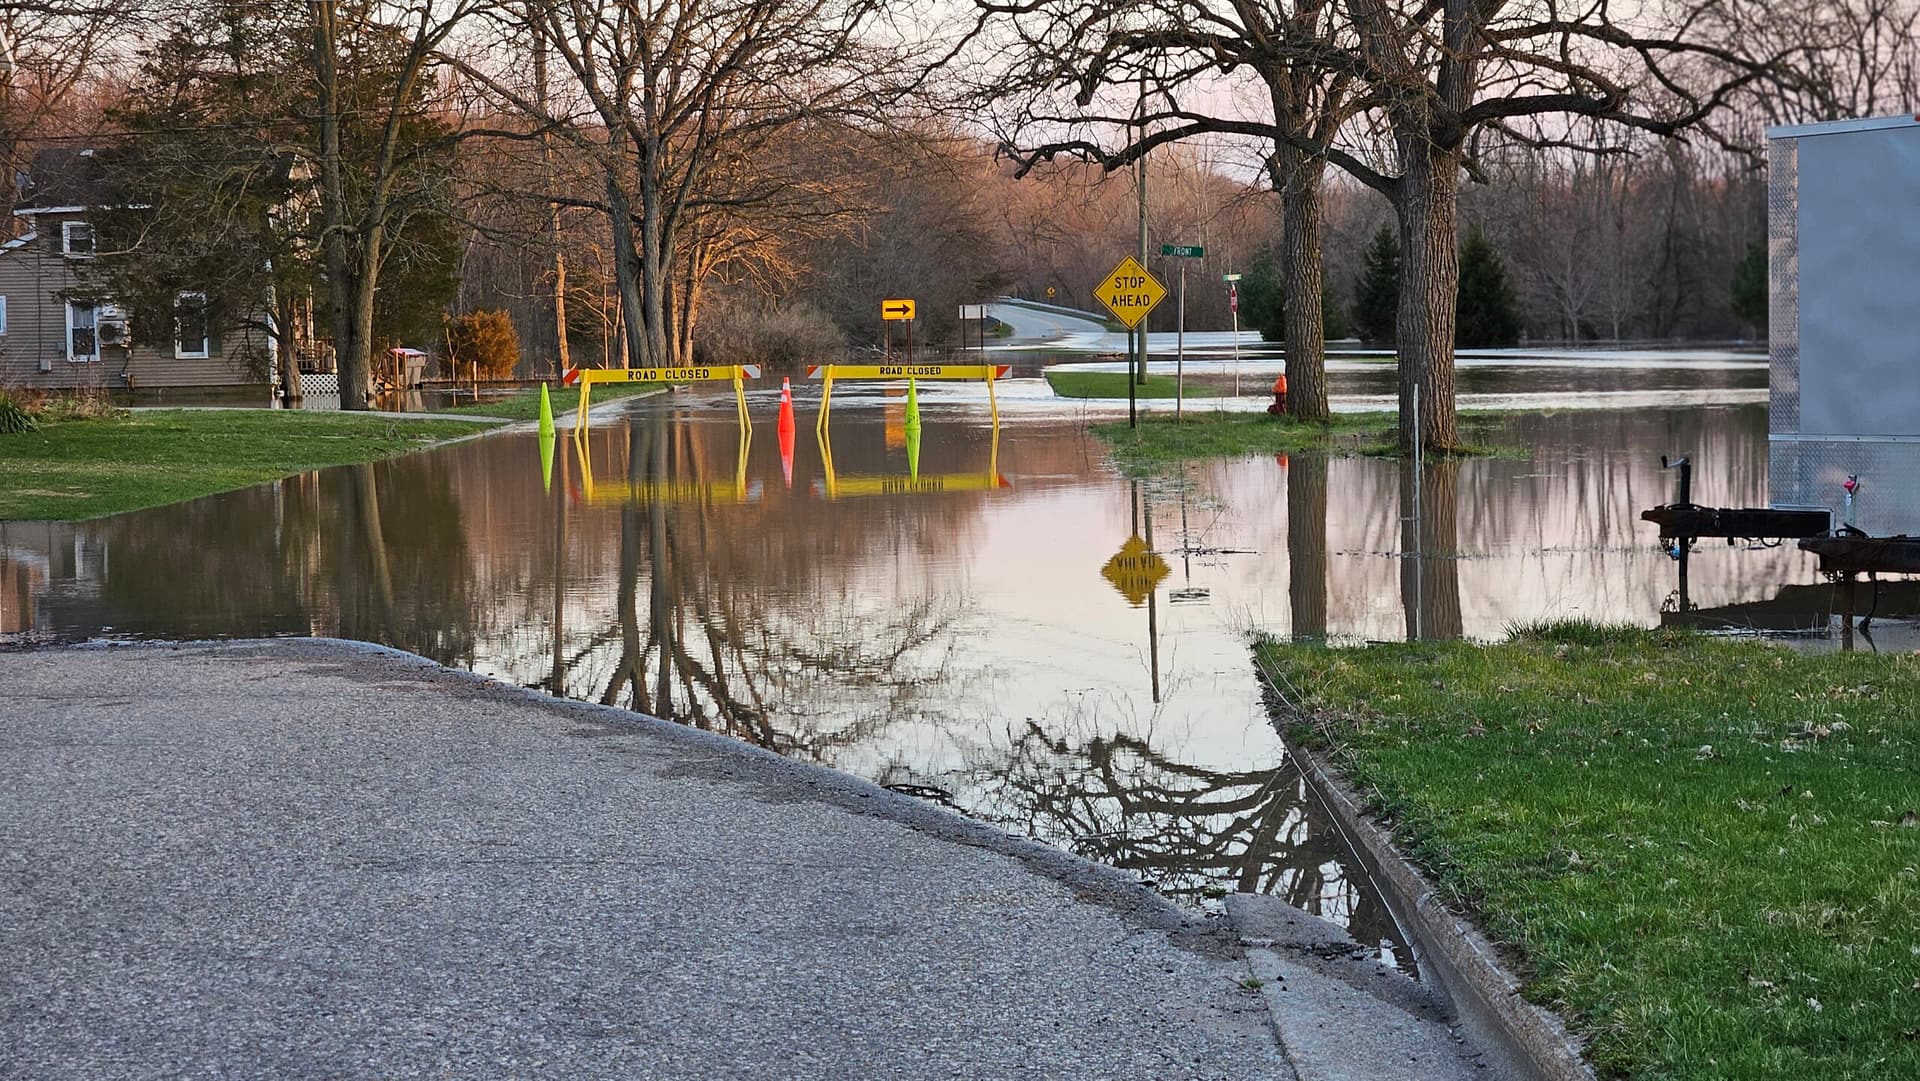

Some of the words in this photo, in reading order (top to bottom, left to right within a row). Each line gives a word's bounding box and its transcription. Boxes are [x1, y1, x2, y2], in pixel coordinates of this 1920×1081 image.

[1173, 246, 1192, 256] FRONT
[1114, 276, 1146, 289] STOP
[1111, 294, 1150, 307] AHEAD
[627, 370, 657, 381] ROAD
[665, 368, 710, 379] CLOSED
[879, 366, 903, 375] ROAD
[907, 366, 942, 375] CLOSED
